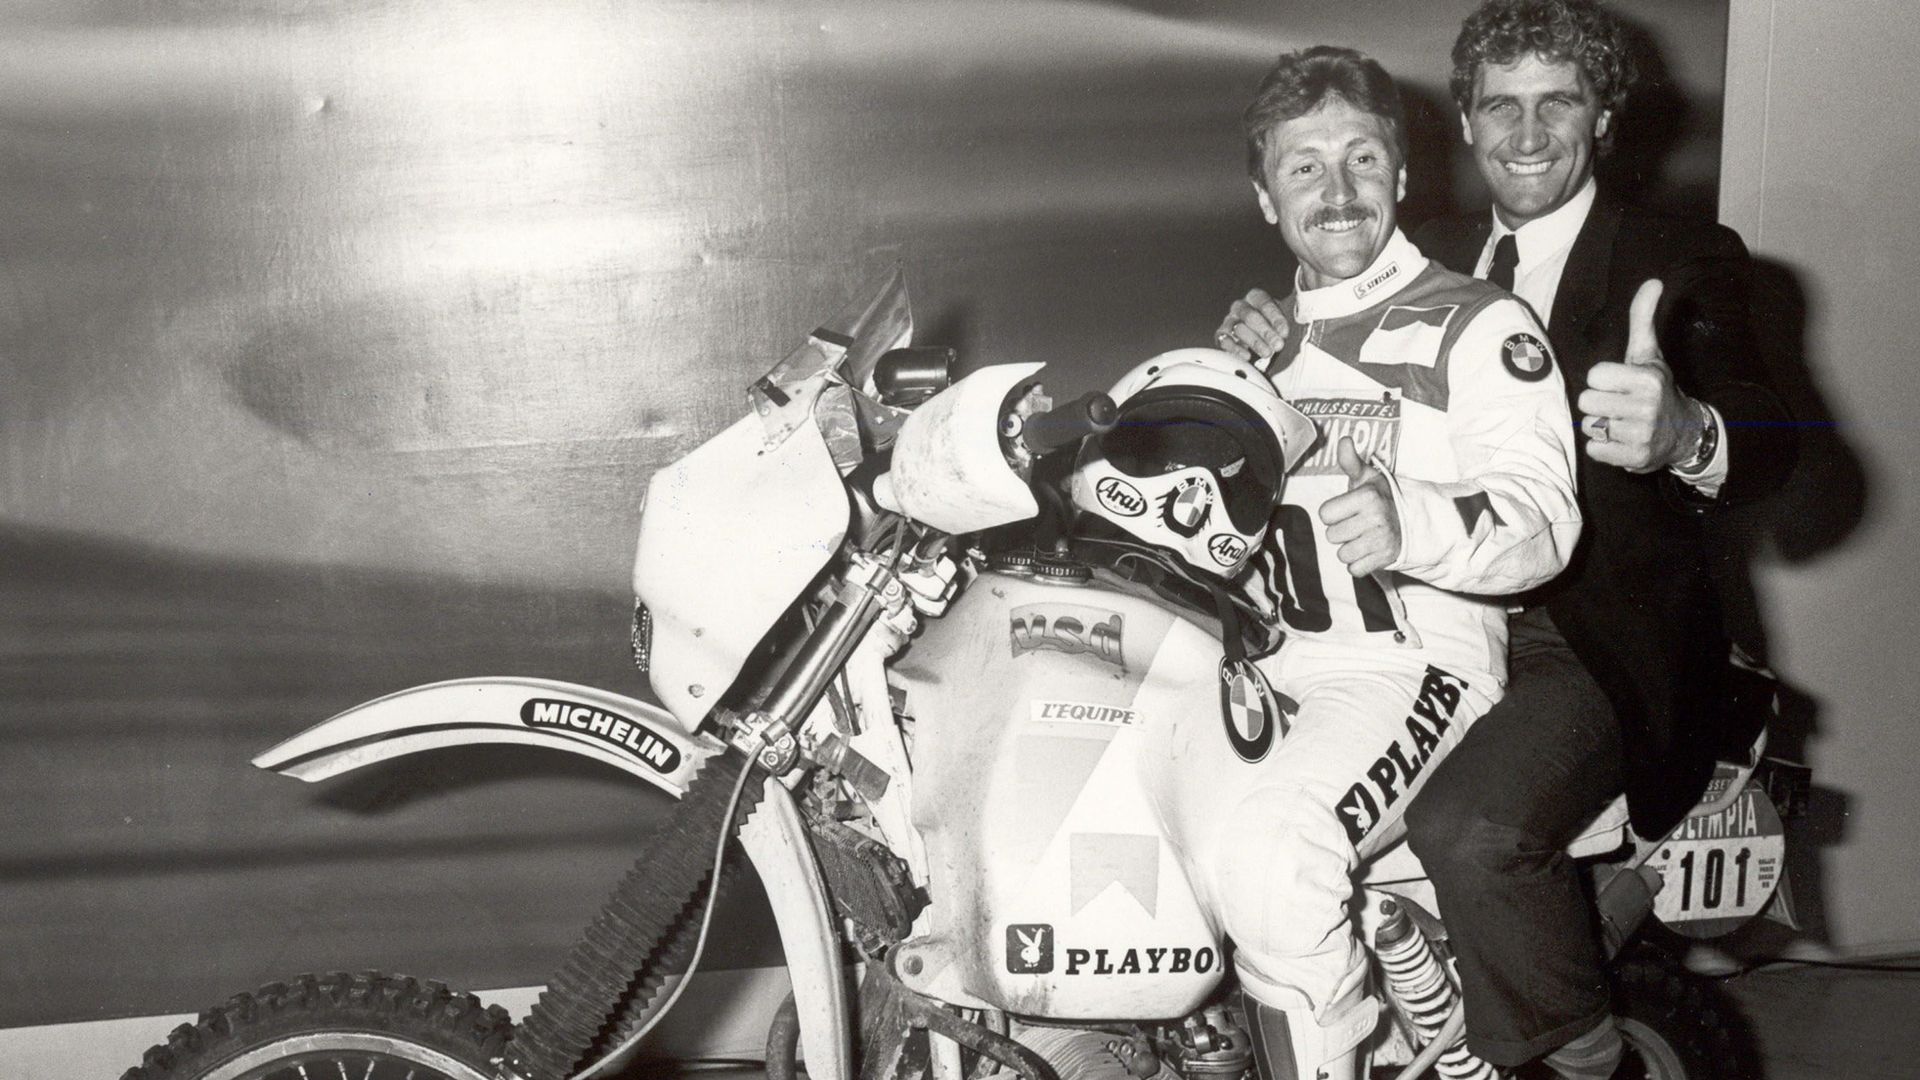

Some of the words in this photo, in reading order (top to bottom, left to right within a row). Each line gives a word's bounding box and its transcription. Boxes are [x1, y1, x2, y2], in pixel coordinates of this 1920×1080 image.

[1504, 334, 1546, 352] BMW
[1097, 480, 1144, 512] Arai
[1208, 536, 1245, 562] Arai
[1222, 661, 1266, 698] BMW
[532, 702, 674, 768] MICHELIN
[1680, 847, 1752, 911] 101
[1065, 946, 1222, 976] PLAYBO
